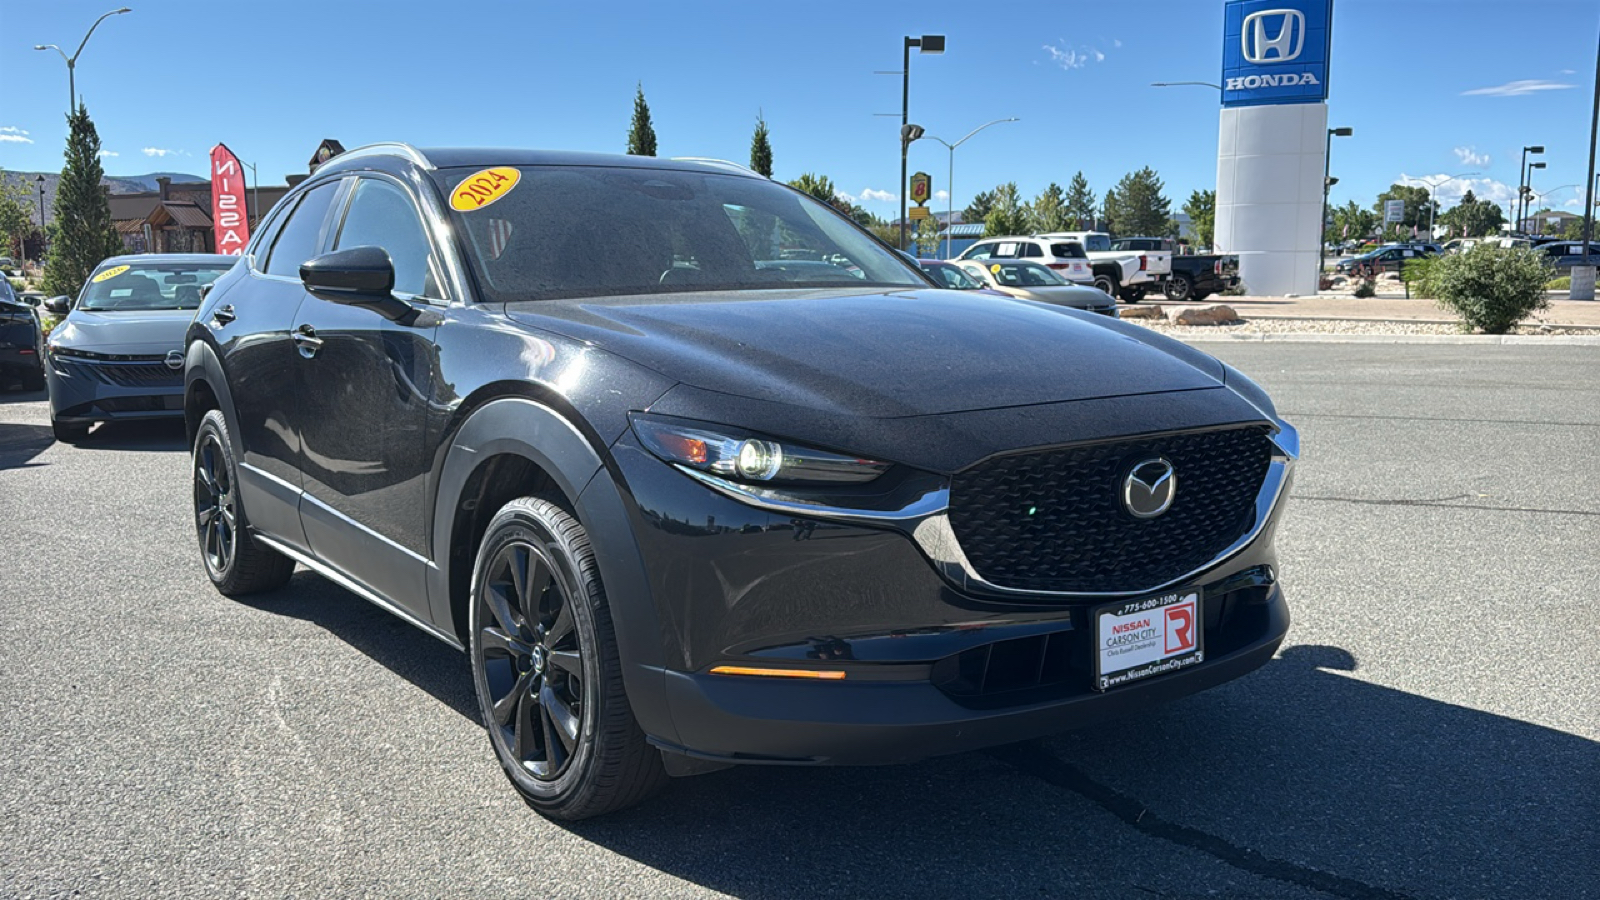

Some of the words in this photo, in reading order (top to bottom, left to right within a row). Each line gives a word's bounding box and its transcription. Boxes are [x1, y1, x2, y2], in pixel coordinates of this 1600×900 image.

[1226, 73, 1320, 90] HONDA
[459, 170, 509, 205] 2024
[914, 182, 926, 197] 8
[1124, 594, 1177, 613] 775-600-1500
[1112, 619, 1150, 635] NISSAN
[1106, 632, 1140, 647] CARSON
[1141, 627, 1156, 640] CITY
